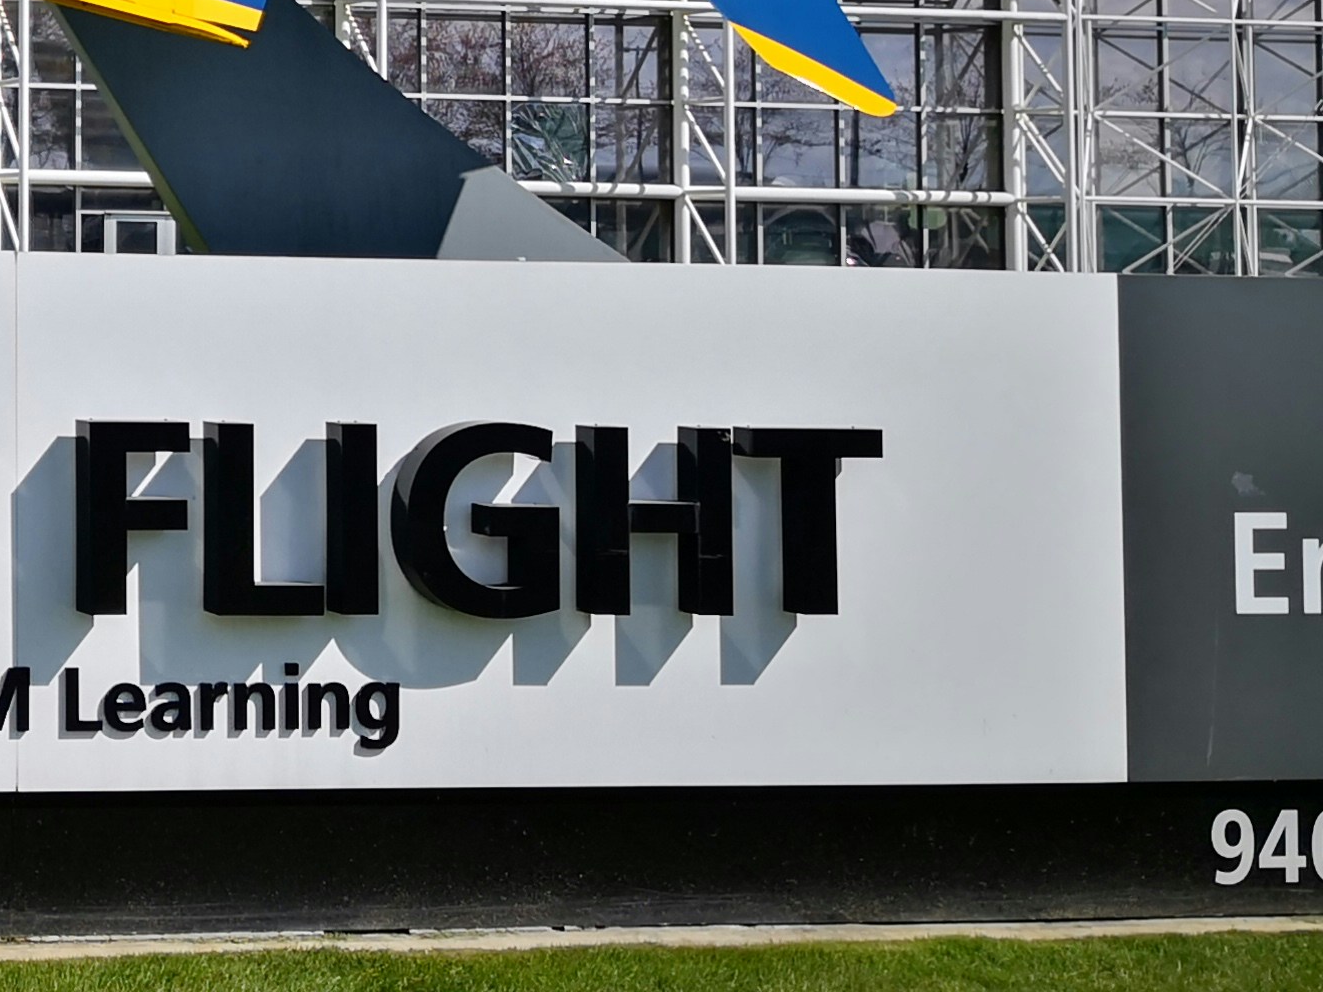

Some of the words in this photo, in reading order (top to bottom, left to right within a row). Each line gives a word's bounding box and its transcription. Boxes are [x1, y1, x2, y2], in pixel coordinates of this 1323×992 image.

[75, 420, 882, 619] FLIGHT
[64, 662, 400, 750] Learning
[1211, 809, 1323, 885] 94
